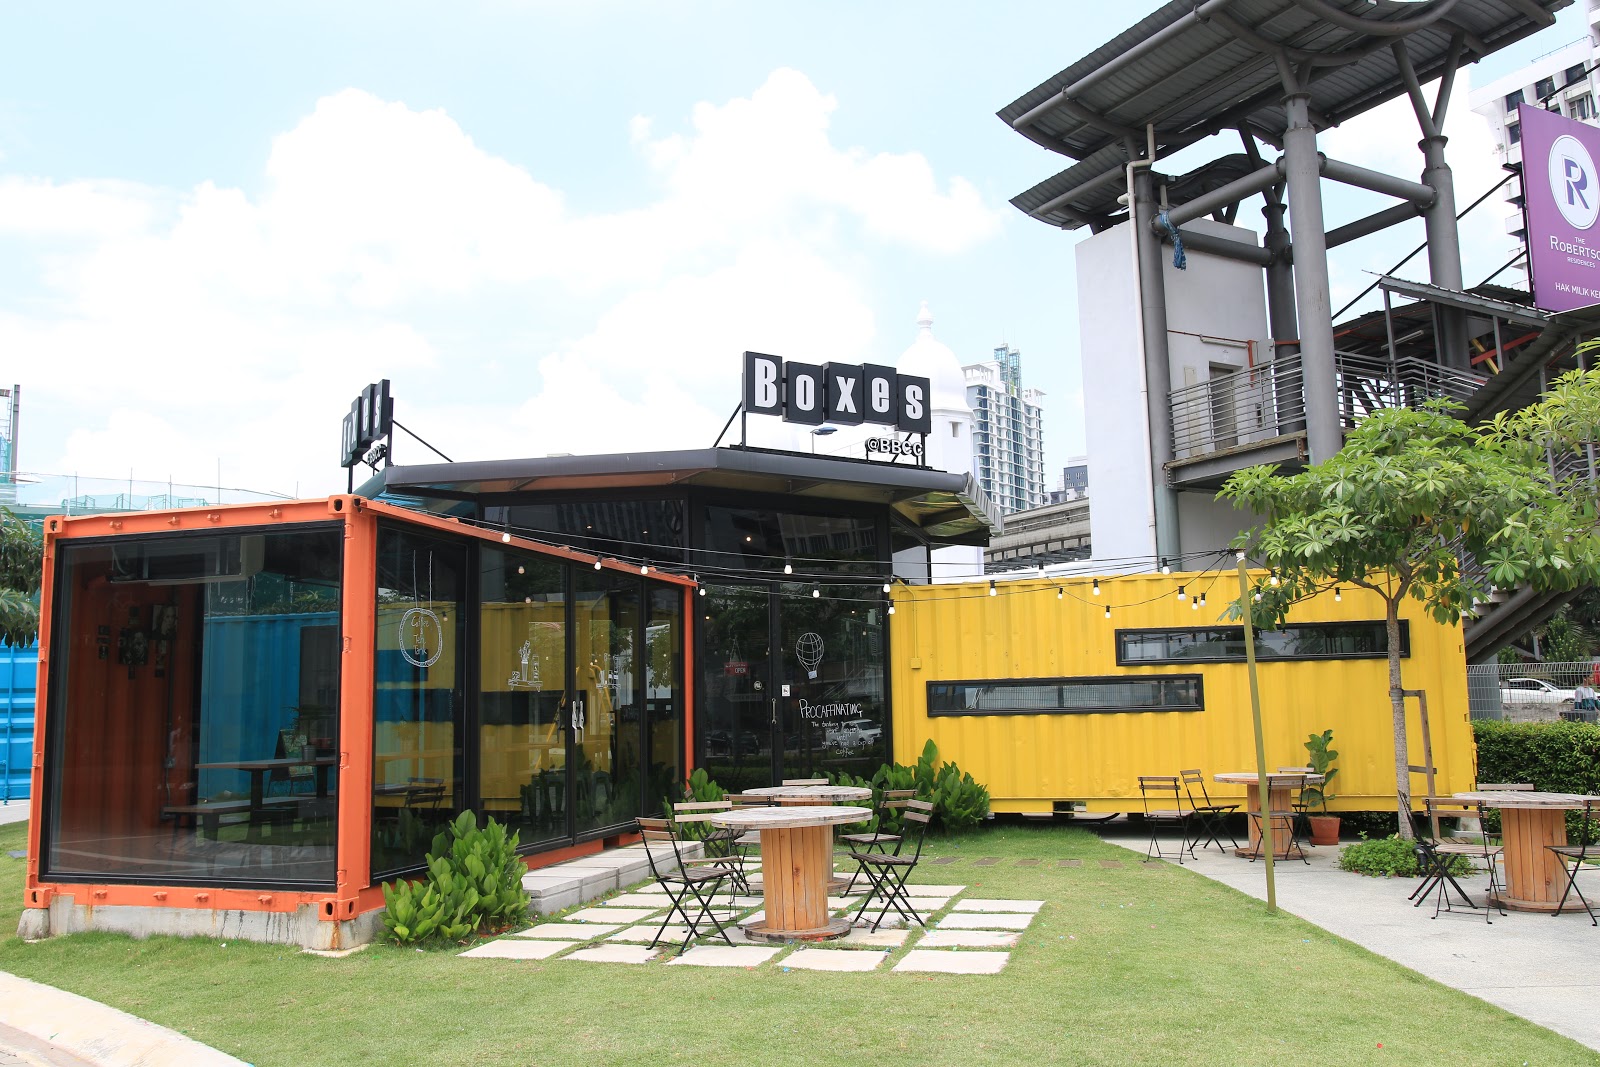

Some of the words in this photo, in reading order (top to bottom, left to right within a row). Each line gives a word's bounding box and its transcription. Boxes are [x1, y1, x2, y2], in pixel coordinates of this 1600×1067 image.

[1561, 154, 1590, 210] R
[1574, 236, 1586, 245] THE
[1567, 256, 1596, 268] RESIDENCES
[1555, 282, 1571, 293] HAK
[1571, 285, 1589, 297] MILIK
[1590, 289, 1600, 299] KE
[754, 357, 924, 420] Boxes
[866, 437, 924, 457] @BBCC
